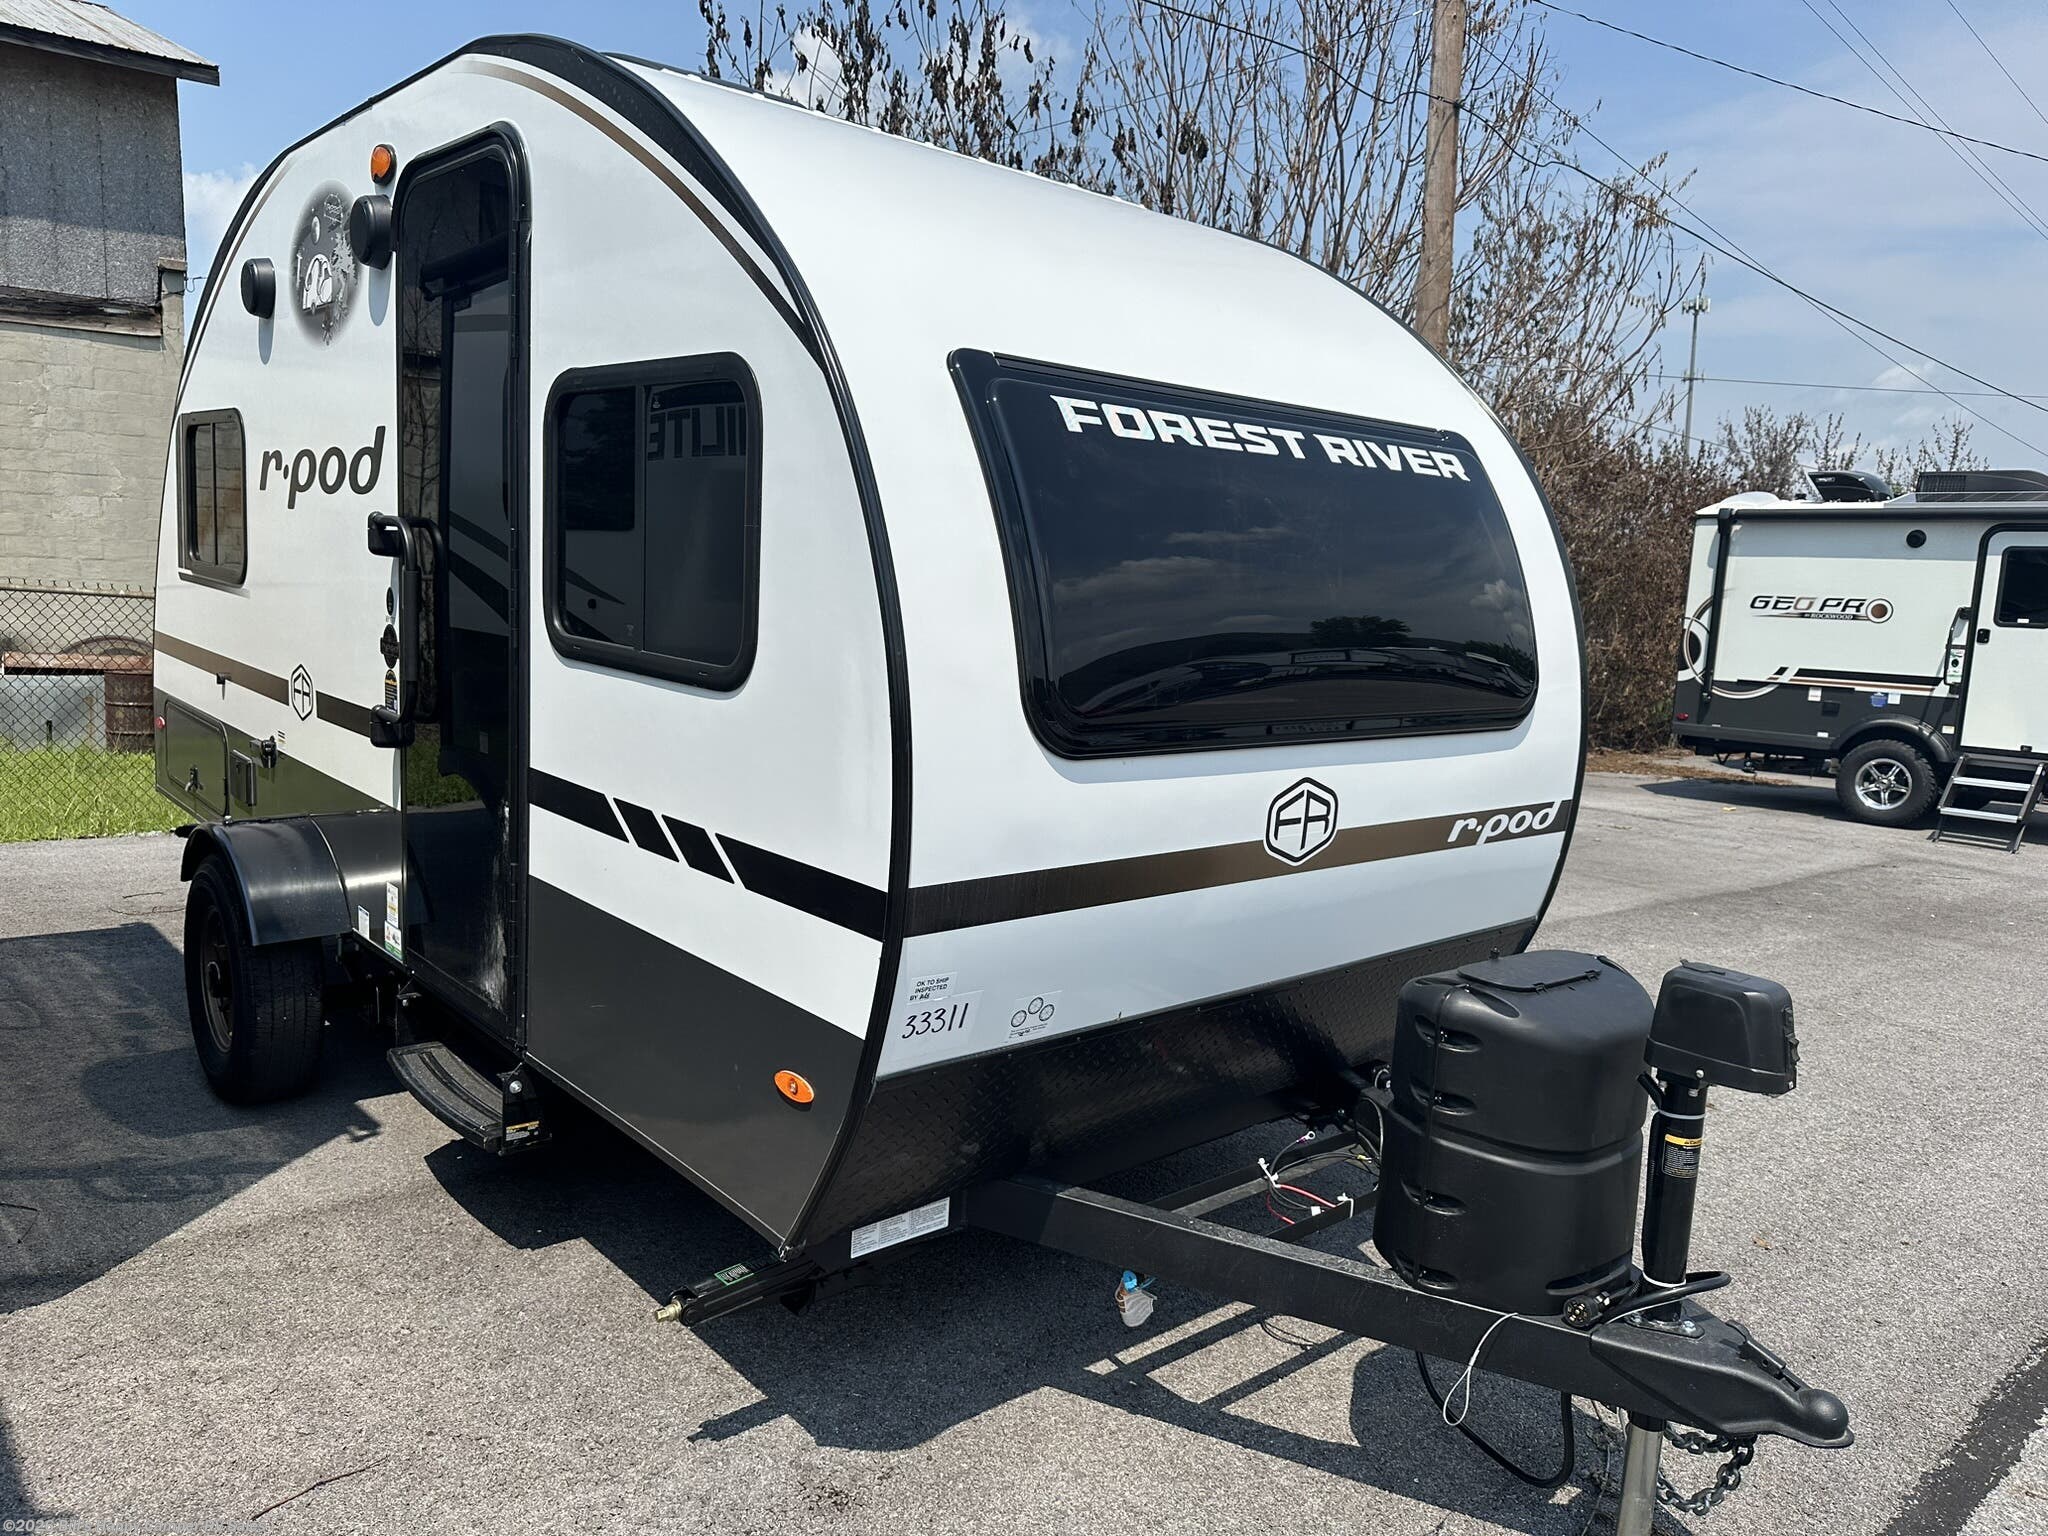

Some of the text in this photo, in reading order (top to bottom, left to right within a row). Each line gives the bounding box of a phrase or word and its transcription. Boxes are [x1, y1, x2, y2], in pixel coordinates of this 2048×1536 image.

[1050, 394, 1470, 482] FOREST RIVER
[1750, 595, 1894, 624] GEO PRO
[1810, 613, 1854, 621] ROCKWOOD
[914, 983, 948, 993] INSPECTED
[935, 976, 950, 985] SHIP
[901, 1002, 970, 1040] 33311
